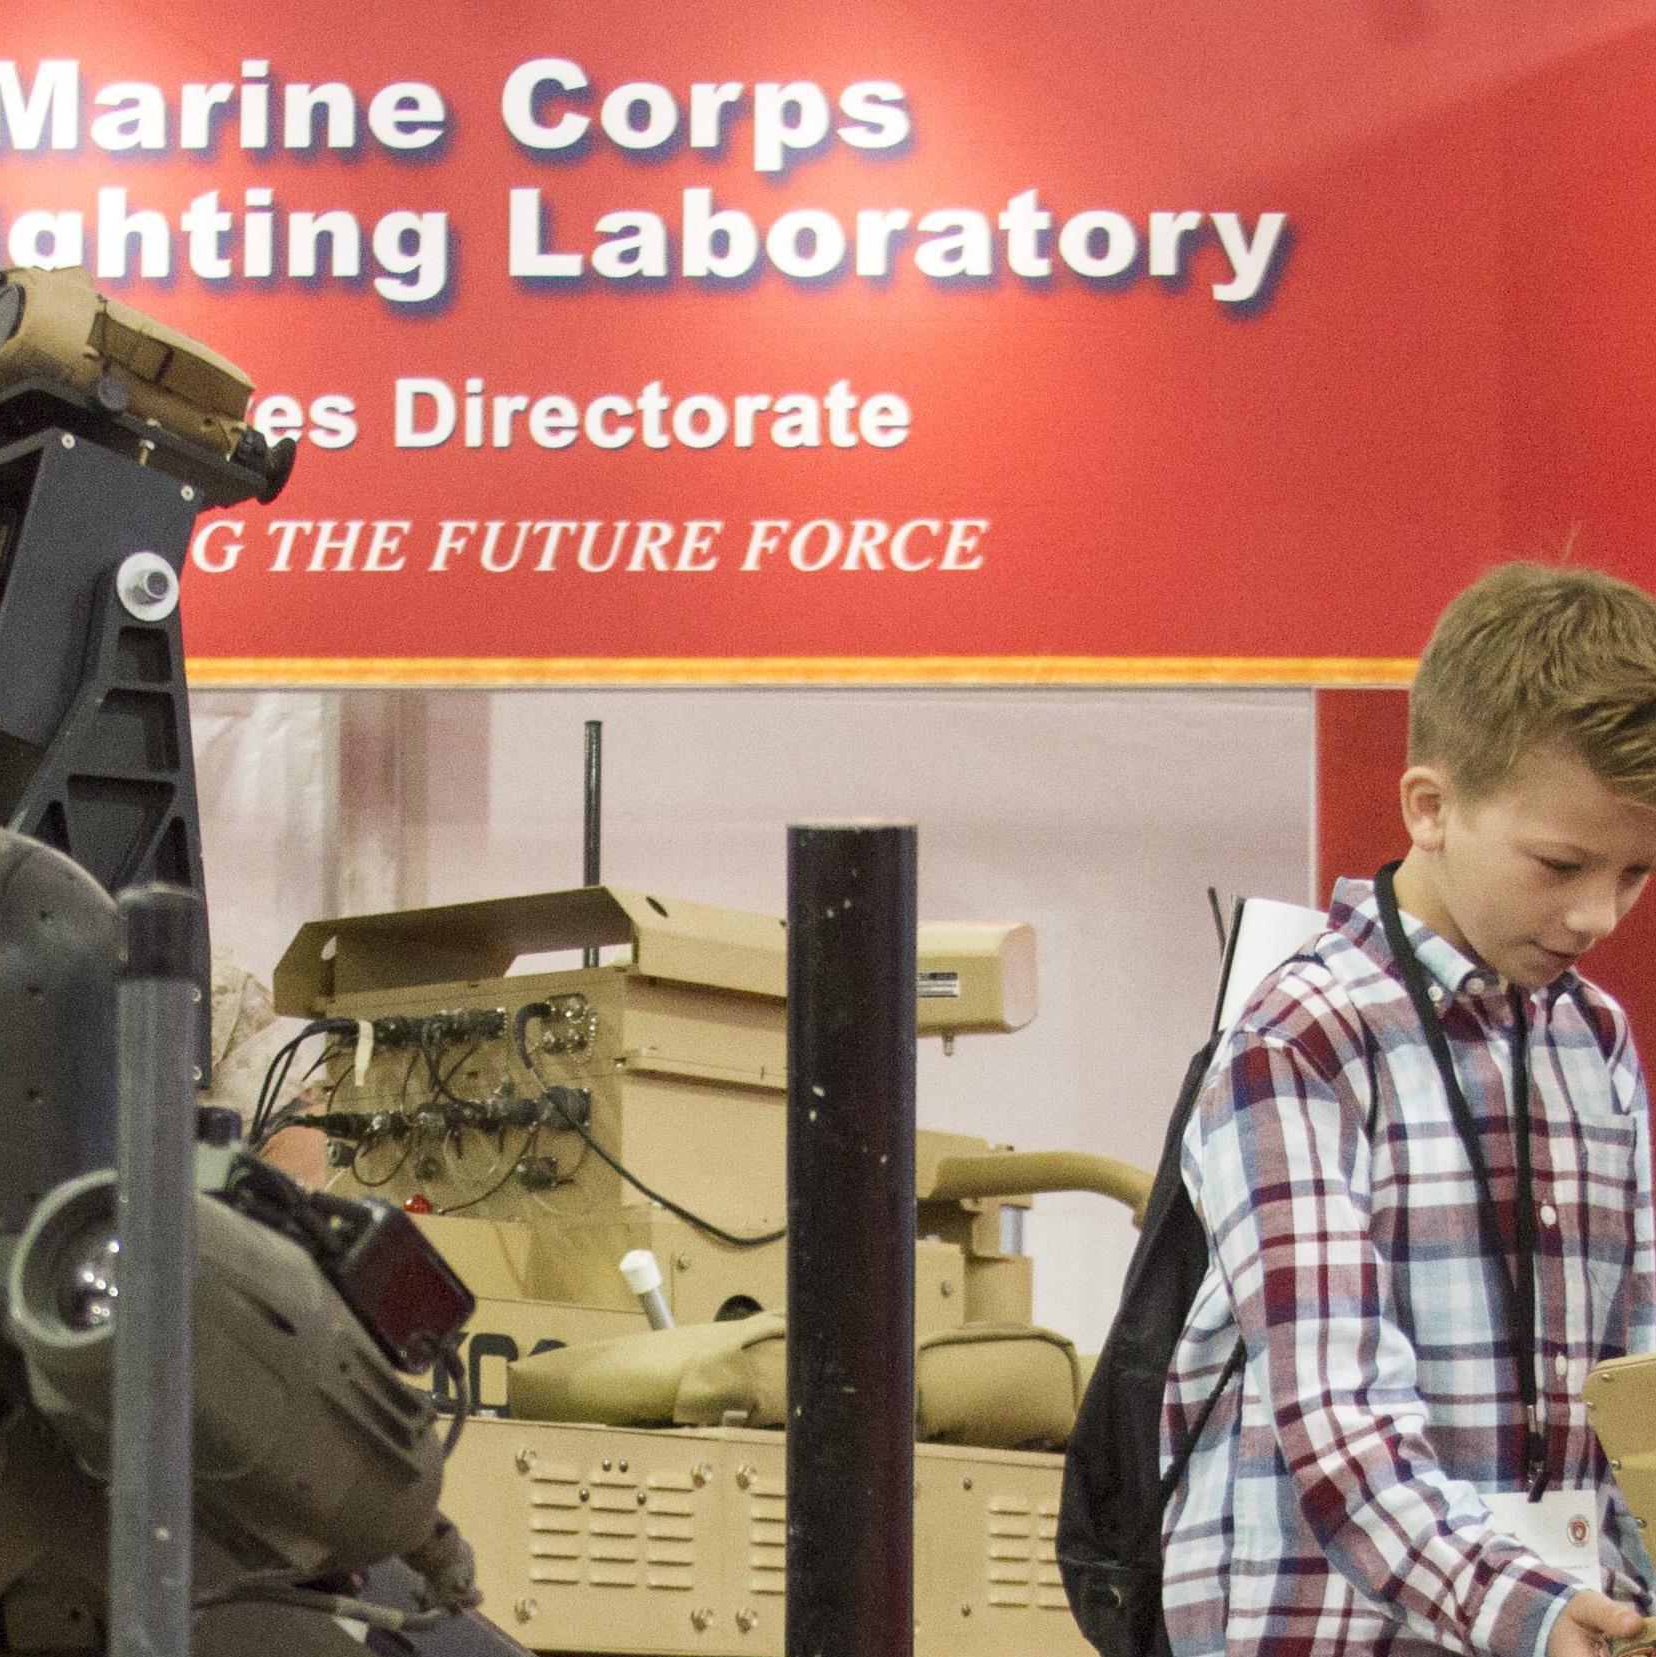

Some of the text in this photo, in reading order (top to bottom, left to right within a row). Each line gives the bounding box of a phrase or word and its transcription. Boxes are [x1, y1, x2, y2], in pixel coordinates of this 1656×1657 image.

[501, 57, 912, 172] Corps
[507, 187, 1288, 303] Laboratory
[394, 377, 912, 451] Directorate
[266, 519, 411, 573] THE
[428, 519, 723, 574] FUTURE
[740, 519, 991, 574] FORCE
